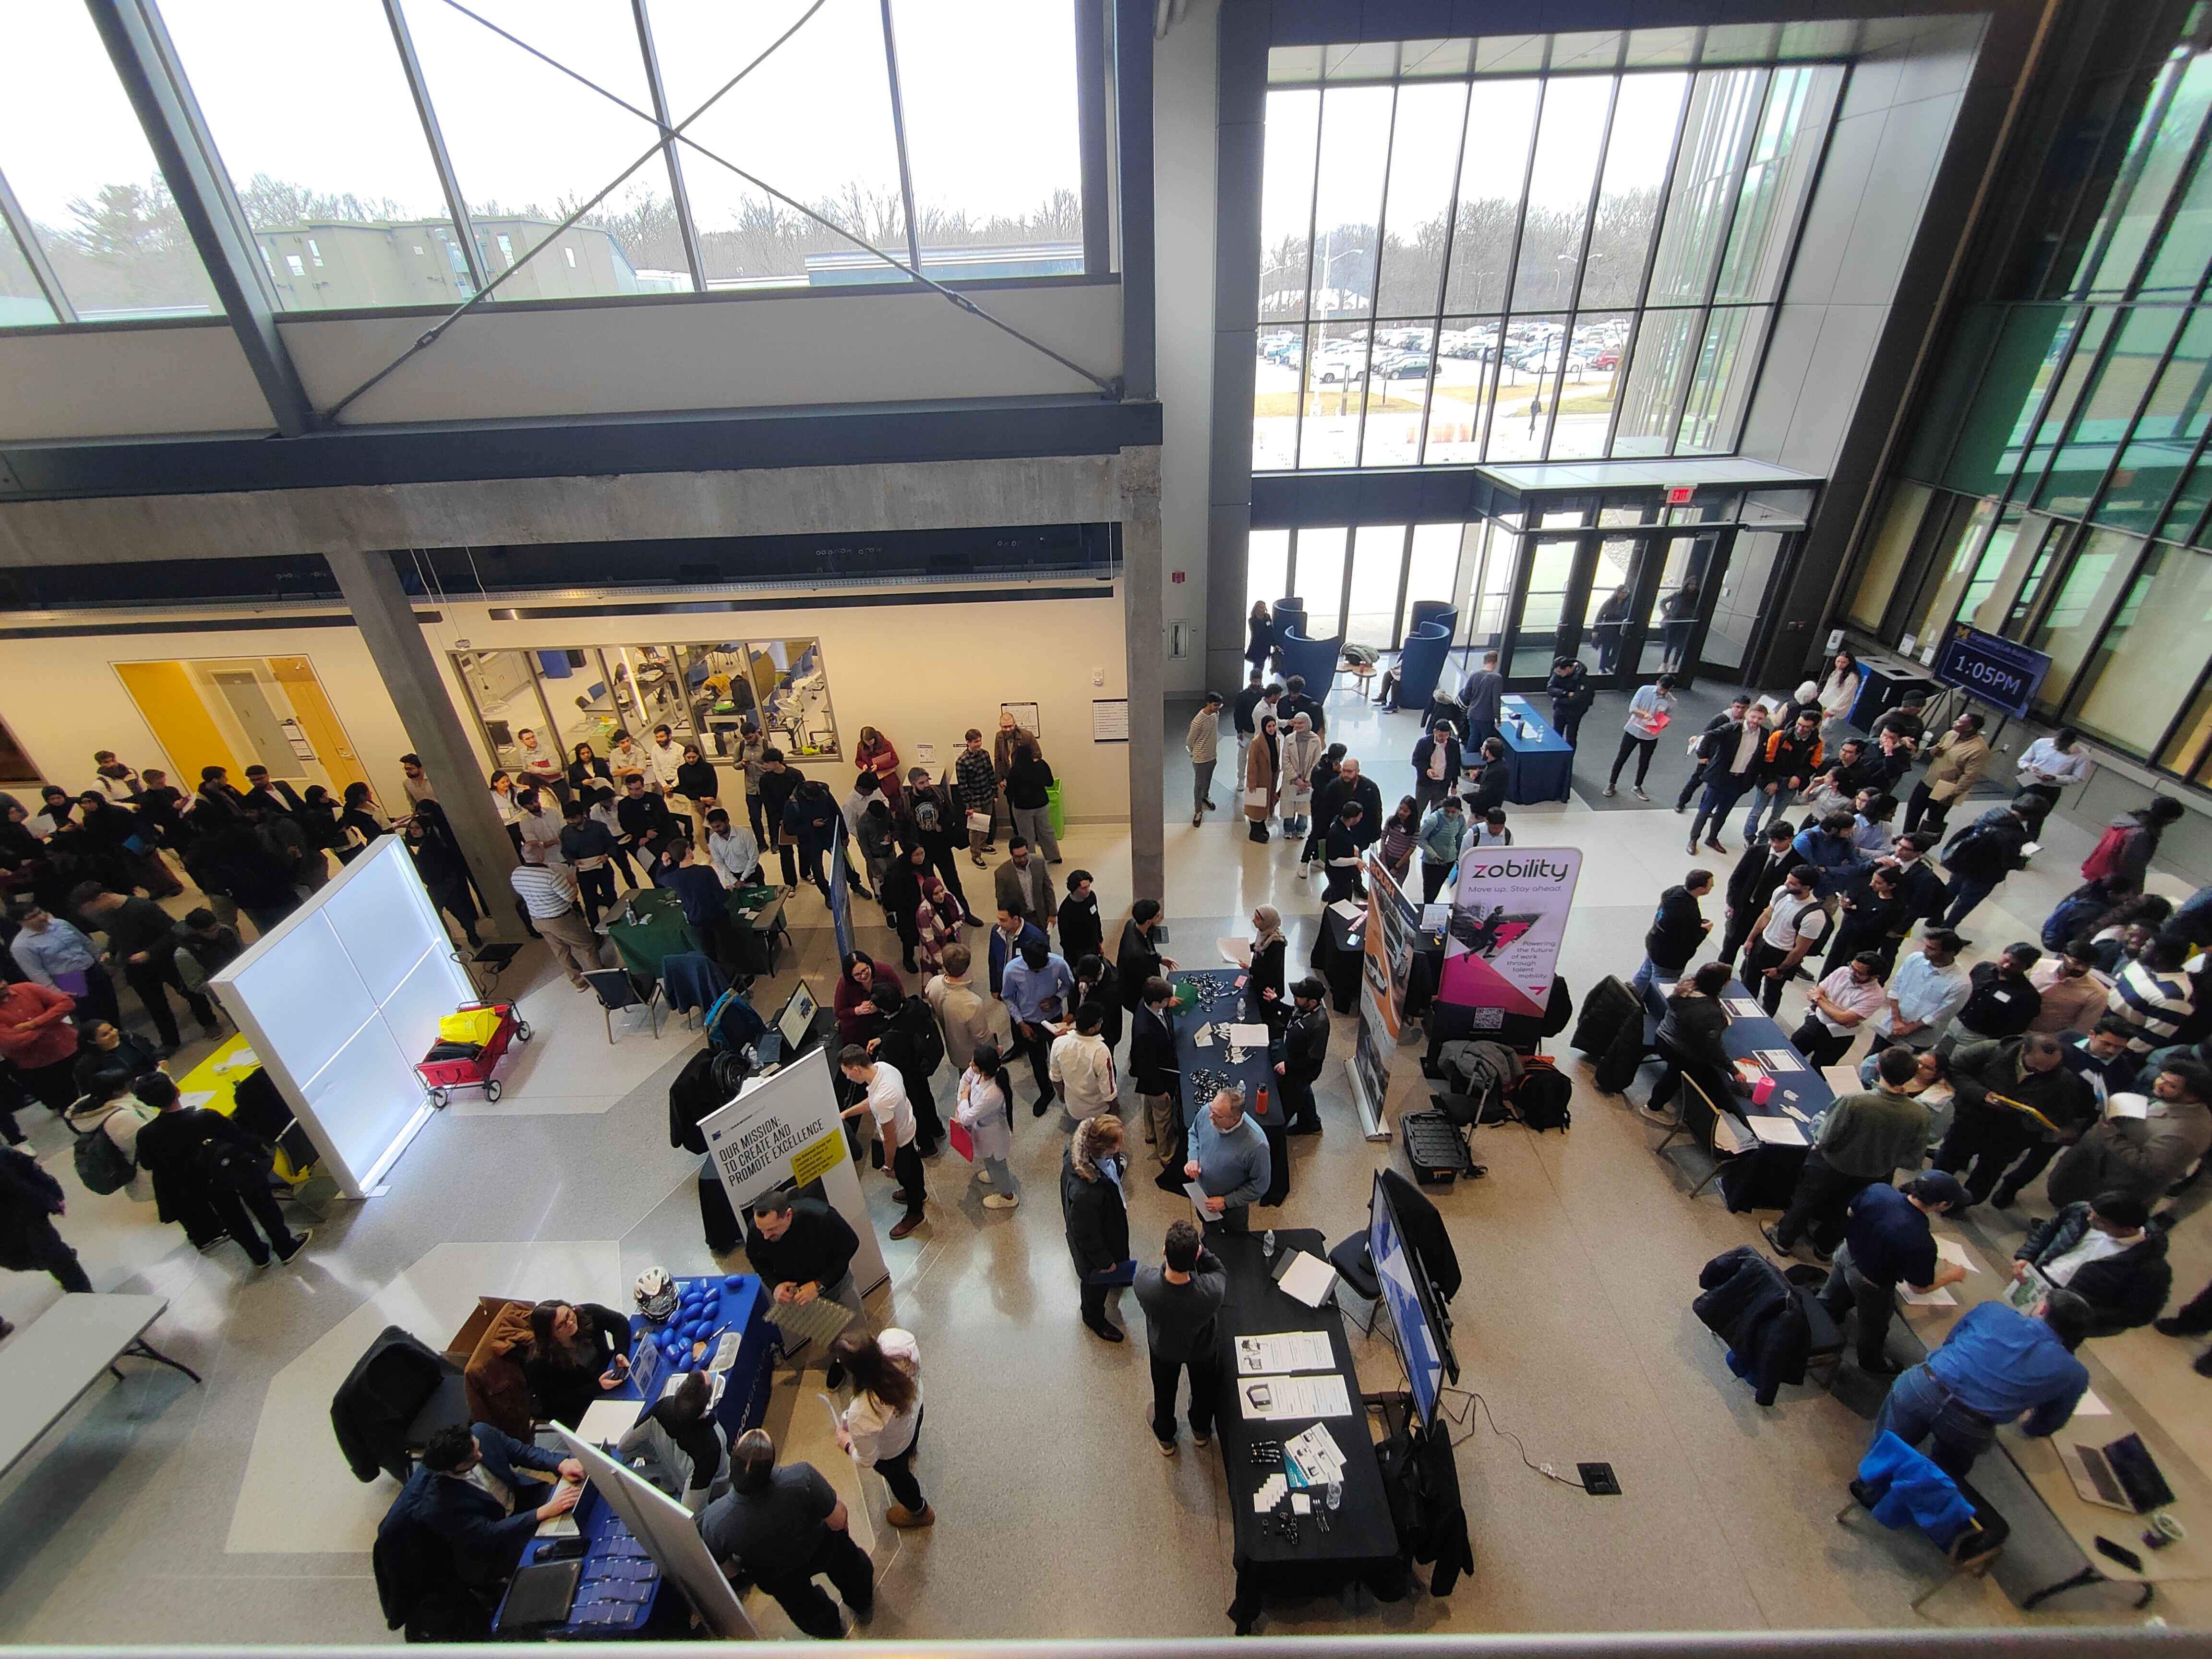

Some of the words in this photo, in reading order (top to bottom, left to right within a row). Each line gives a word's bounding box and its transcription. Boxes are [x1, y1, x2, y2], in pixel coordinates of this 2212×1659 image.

[1955, 655, 2020, 695] 1:05PM
[1370, 861, 1395, 899] ROUSH
[1472, 859, 1568, 882] zobility
[719, 1142, 740, 1162] OUR
[740, 1116, 782, 1150] MISSION:
[730, 1114, 753, 1130] OAKWOOD
[723, 1160, 738, 1175] TO
[738, 1136, 772, 1166] CREATE
[772, 1123, 791, 1143] AND
[728, 1155, 771, 1186] PROMOTE
[772, 1118, 825, 1159] EXCELLENCE
